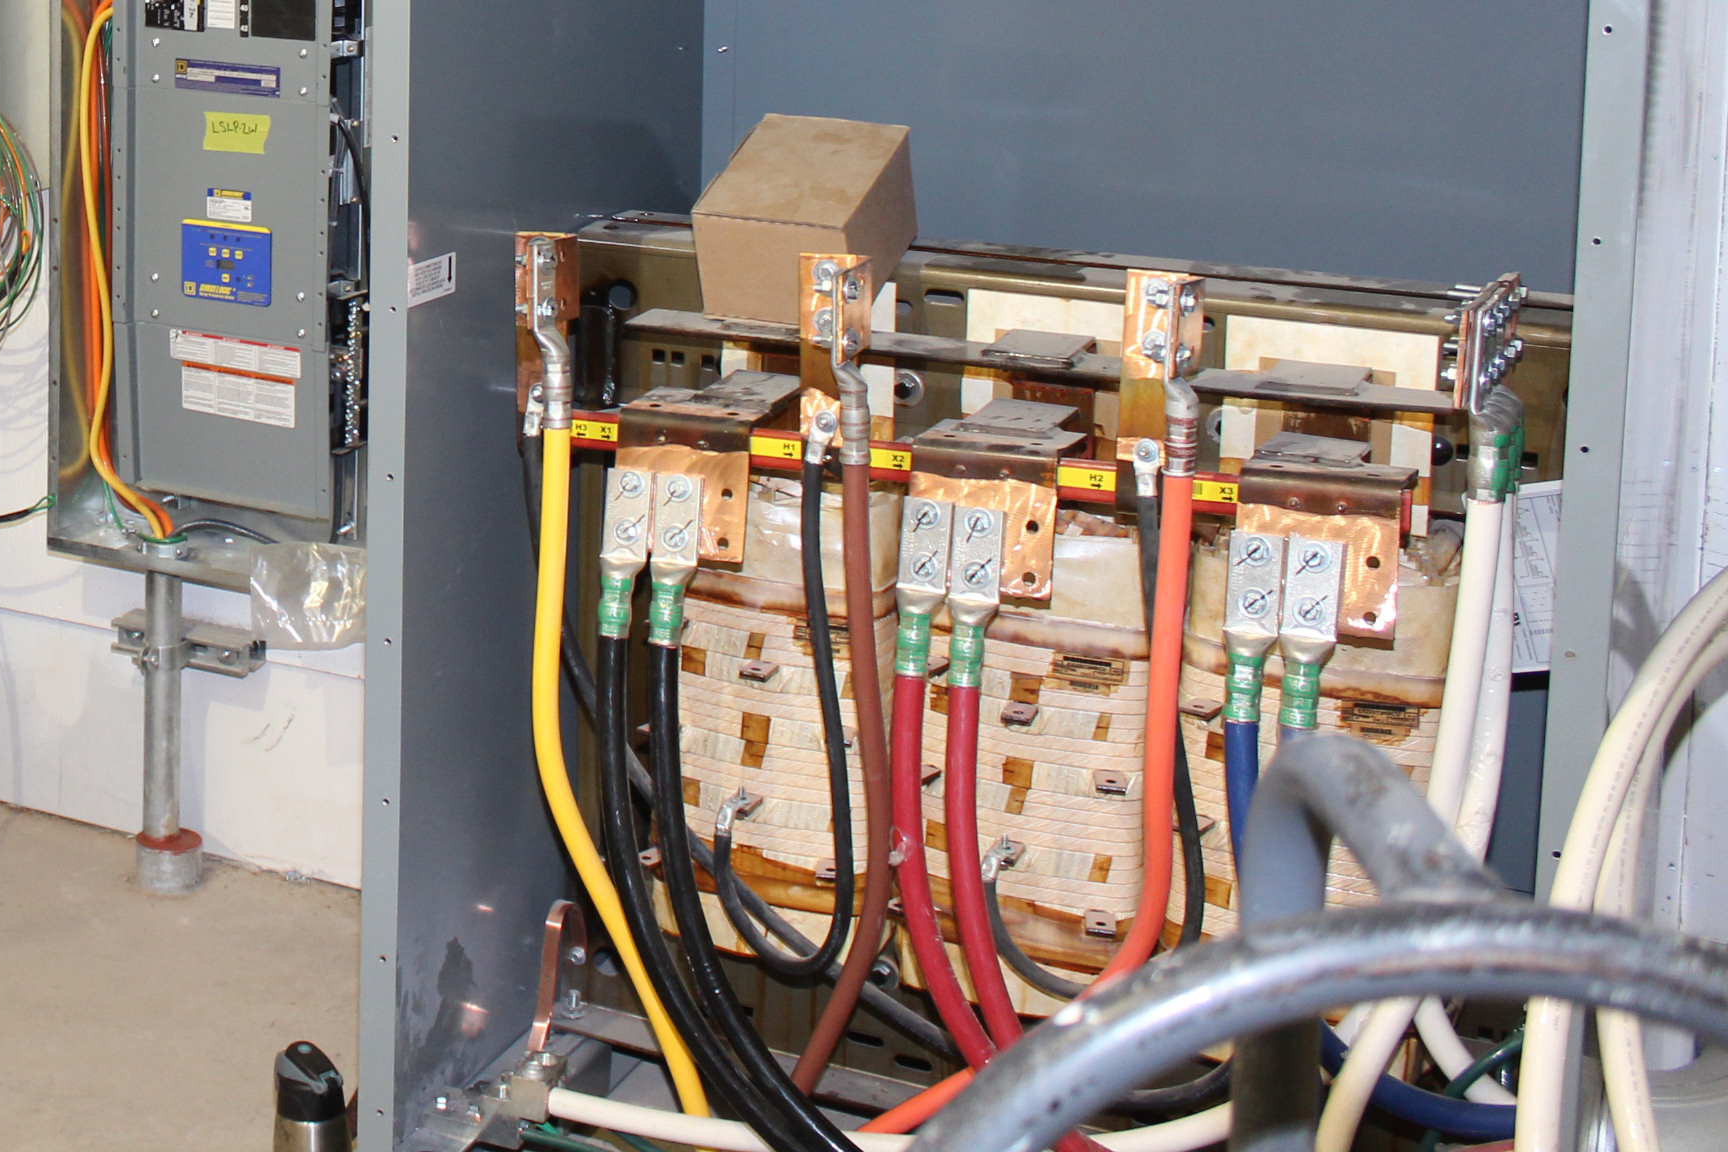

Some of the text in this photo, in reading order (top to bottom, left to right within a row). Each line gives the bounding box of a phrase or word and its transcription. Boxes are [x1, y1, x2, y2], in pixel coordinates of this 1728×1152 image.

[575, 424, 612, 434] H3 X1
[783, 443, 795, 451] H1
[892, 454, 905, 463] X2
[1089, 473, 1104, 483] H2
[1219, 486, 1234, 495] X3
